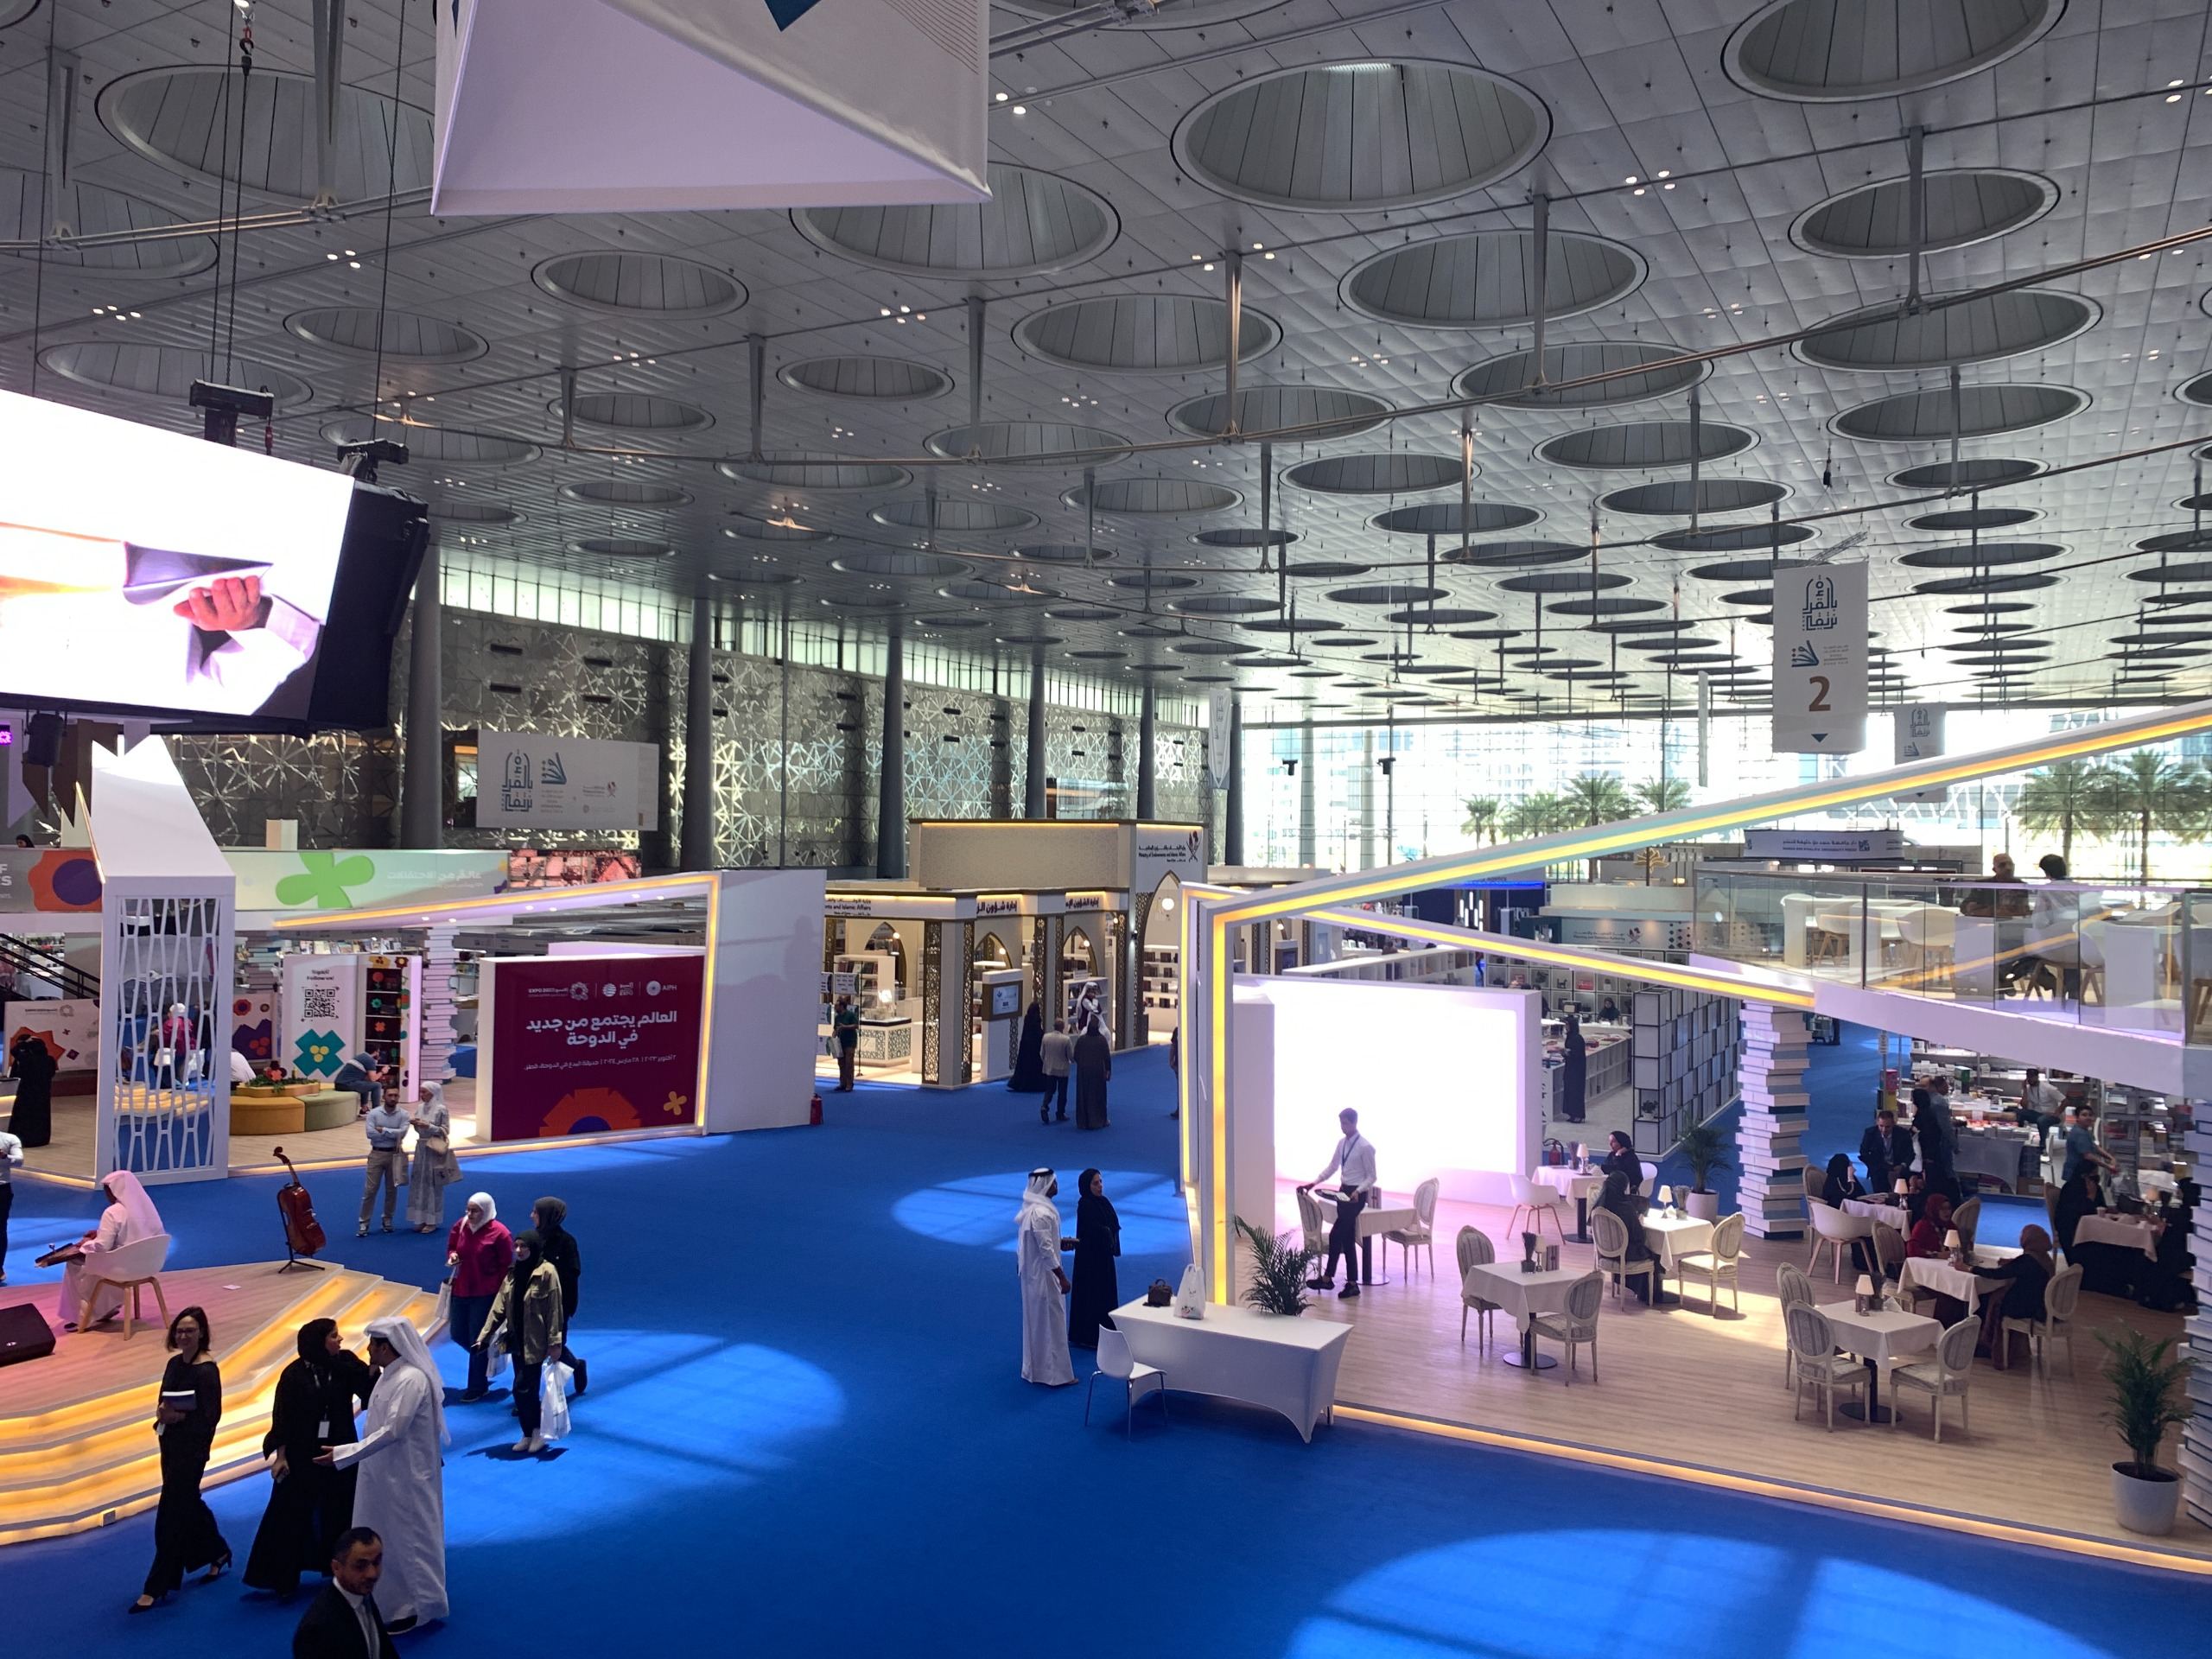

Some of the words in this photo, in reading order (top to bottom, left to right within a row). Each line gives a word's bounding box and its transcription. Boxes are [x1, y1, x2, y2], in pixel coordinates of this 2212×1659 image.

[1808, 676, 1832, 712] 2
[662, 983, 677, 992] AIPH
[525, 1017, 563, 1033] جديد
[564, 1016, 588, 1032] من
[590, 1014, 636, 1032] يجتمع
[637, 1010, 677, 1028] العالم
[566, 1030, 616, 1048] الدوحة
[618, 1029, 639, 1050] في
